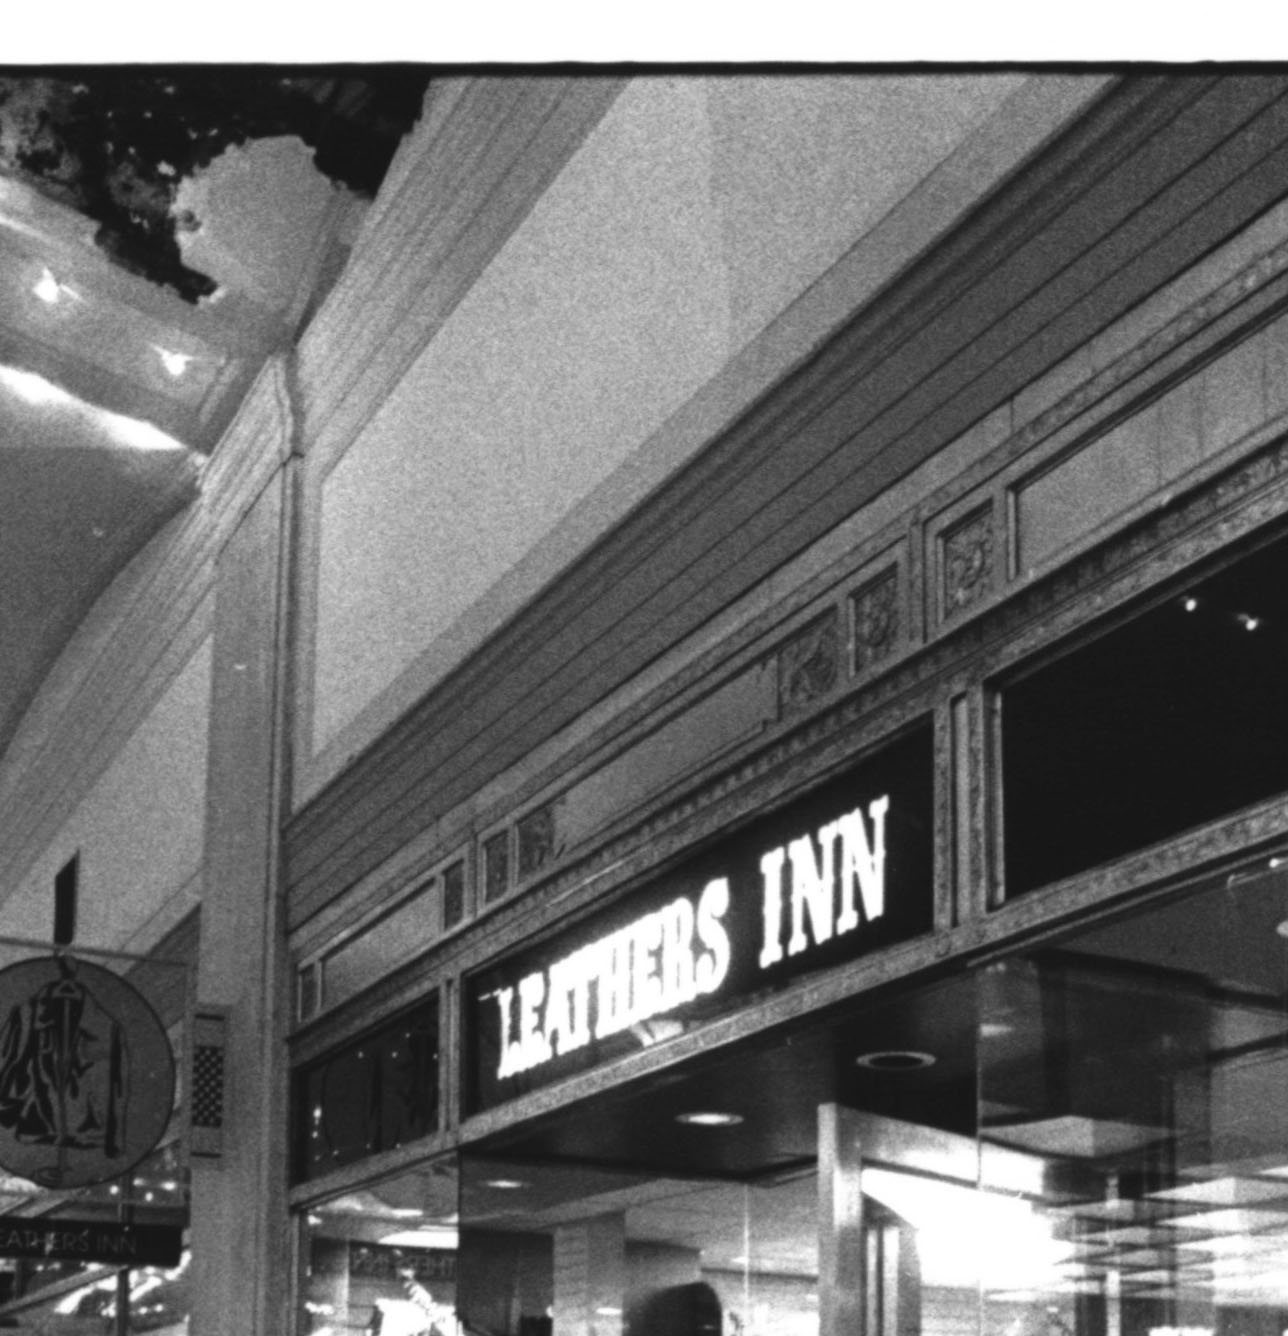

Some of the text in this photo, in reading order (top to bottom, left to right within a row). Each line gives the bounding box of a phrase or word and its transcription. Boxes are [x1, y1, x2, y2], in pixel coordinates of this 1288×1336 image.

[486, 794, 890, 1080] LEATHERS INN
[96, 1233, 138, 1255] INN
